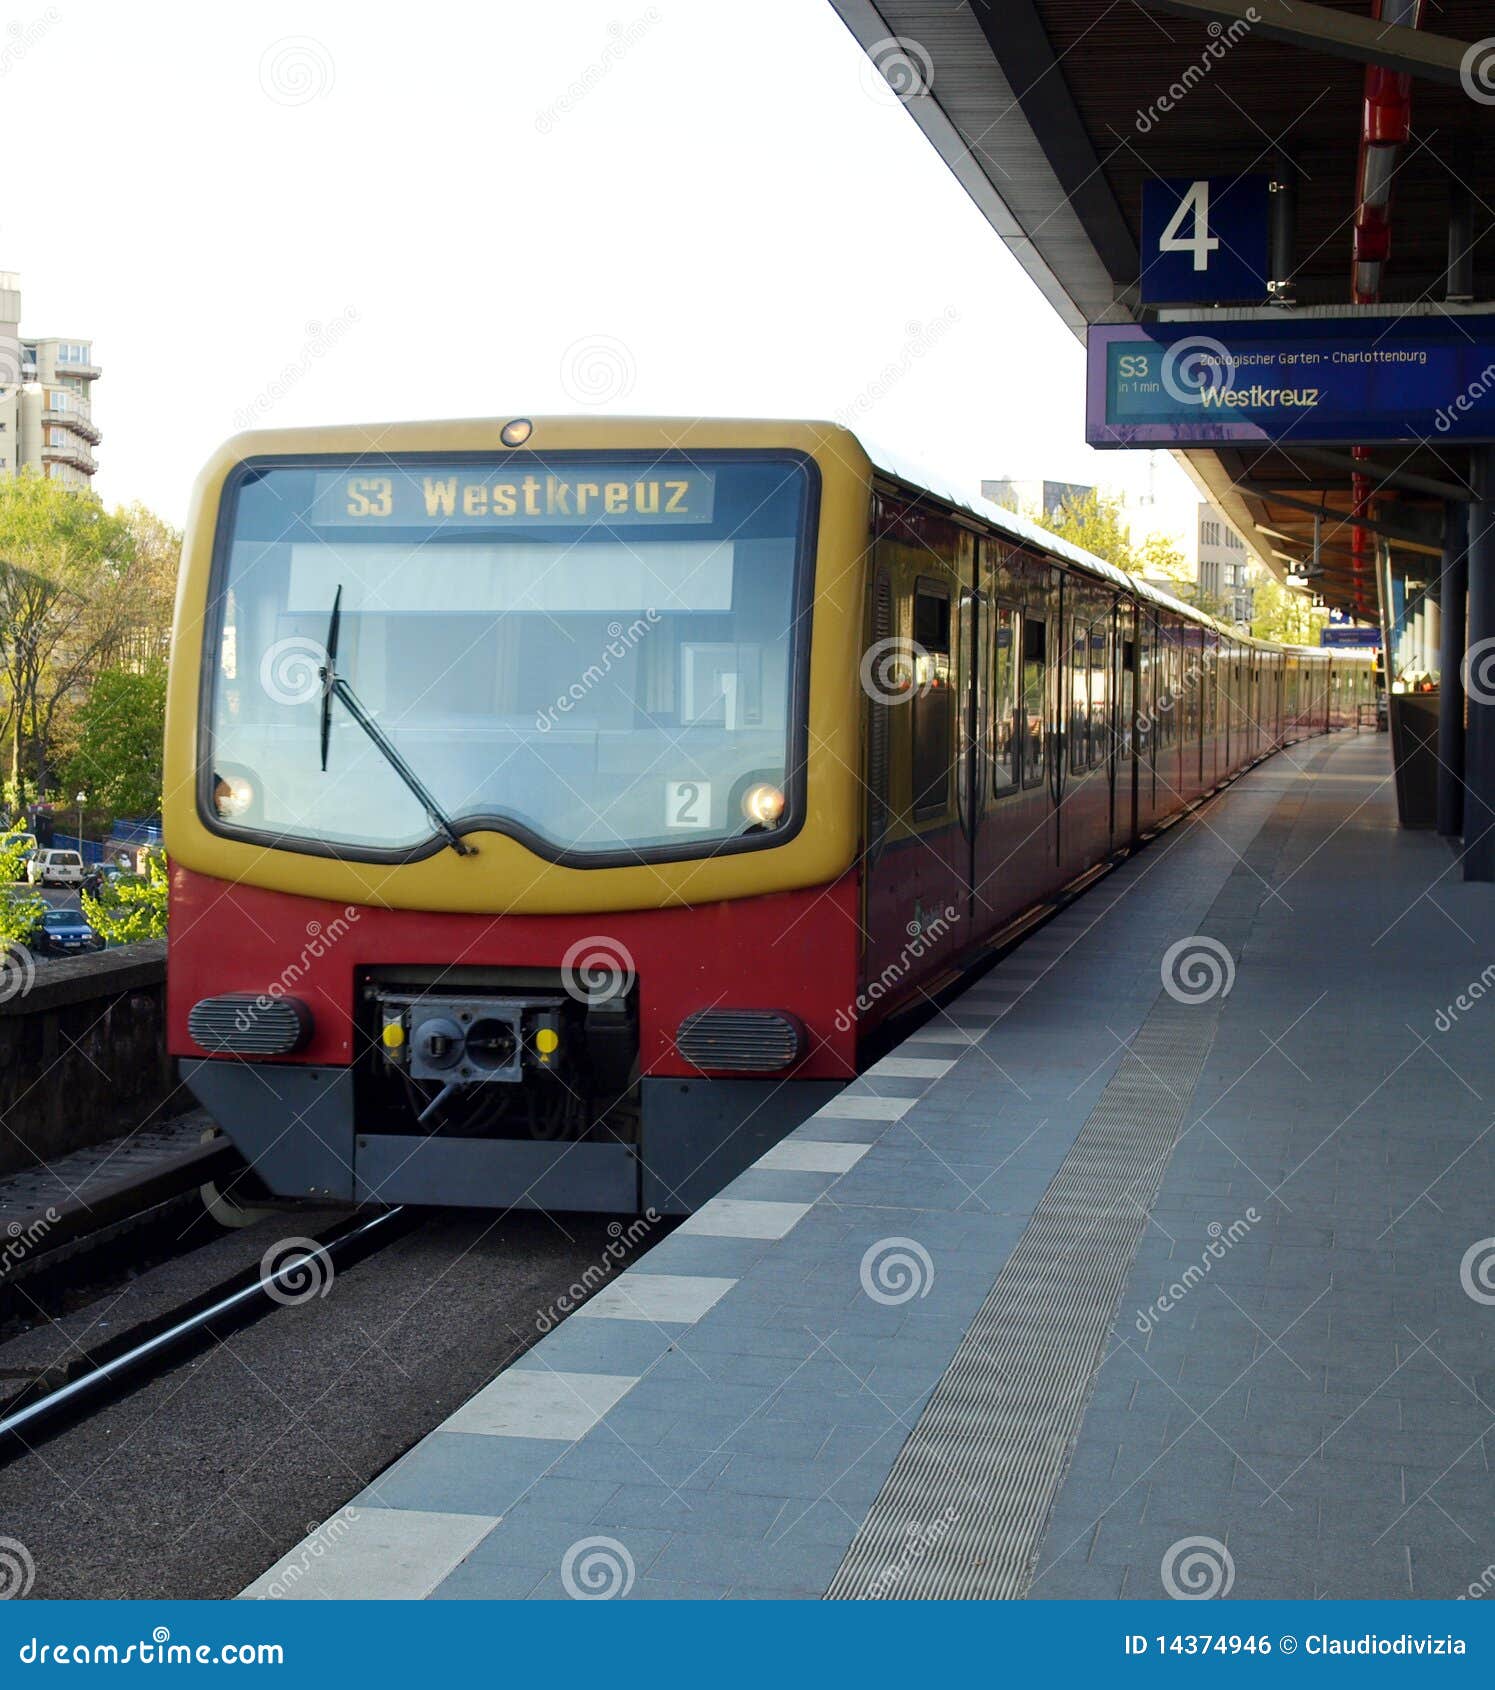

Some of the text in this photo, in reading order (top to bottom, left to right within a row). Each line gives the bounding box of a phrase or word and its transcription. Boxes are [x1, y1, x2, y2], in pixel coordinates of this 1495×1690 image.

[1160, 181, 1219, 271] 4
[1119, 355, 1149, 378] S3
[1200, 353, 1275, 368] Zoologischer
[1278, 352, 1320, 365] Garten
[1332, 350, 1427, 365] Charlottenburg
[1119, 382, 1160, 393] in 1 min
[1200, 384, 1319, 408] Westkreuz
[346, 476, 690, 517] S3 Westkreuz
[676, 783, 699, 823] 2
